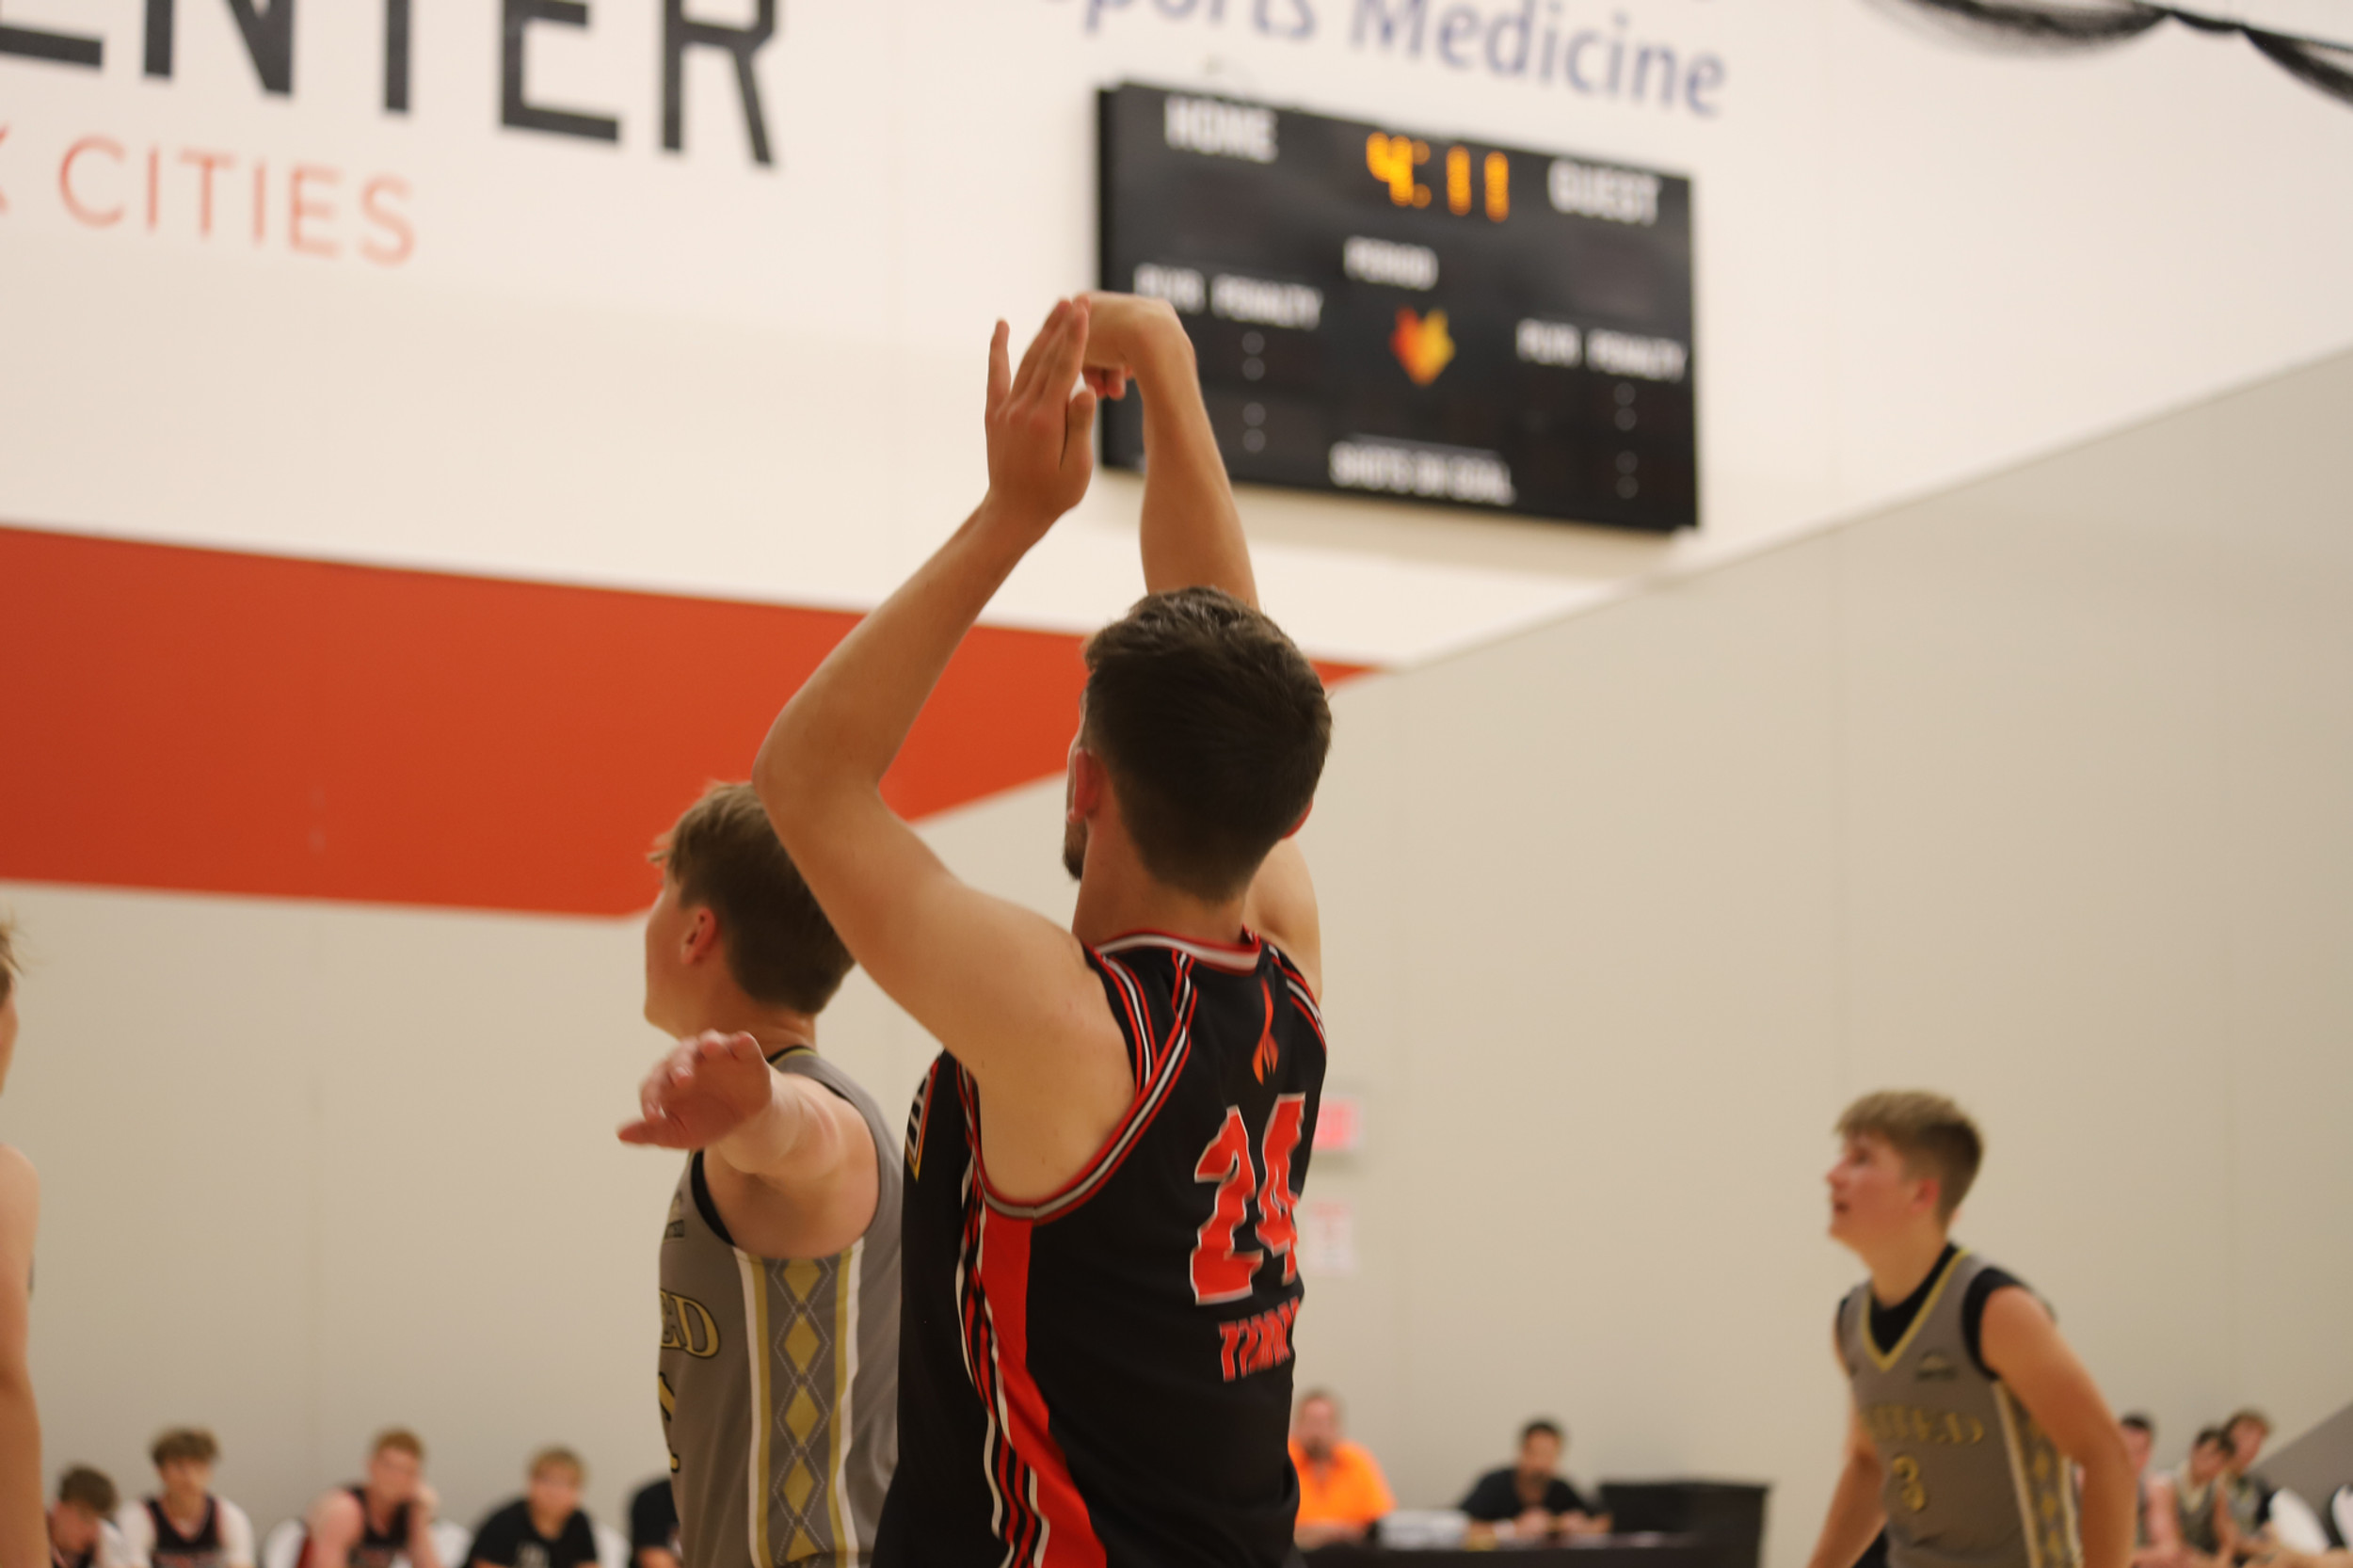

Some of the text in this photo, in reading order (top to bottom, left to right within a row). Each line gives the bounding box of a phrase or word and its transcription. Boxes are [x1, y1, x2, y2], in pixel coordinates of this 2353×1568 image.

[1349, 0, 1726, 119] Medicine
[1165, 96, 1277, 164] HOME
[1366, 132, 1510, 222] 4:11
[58, 134, 416, 267] CITIES
[1548, 158, 1660, 225] GUEST
[1189, 1092, 1306, 1305] 24
